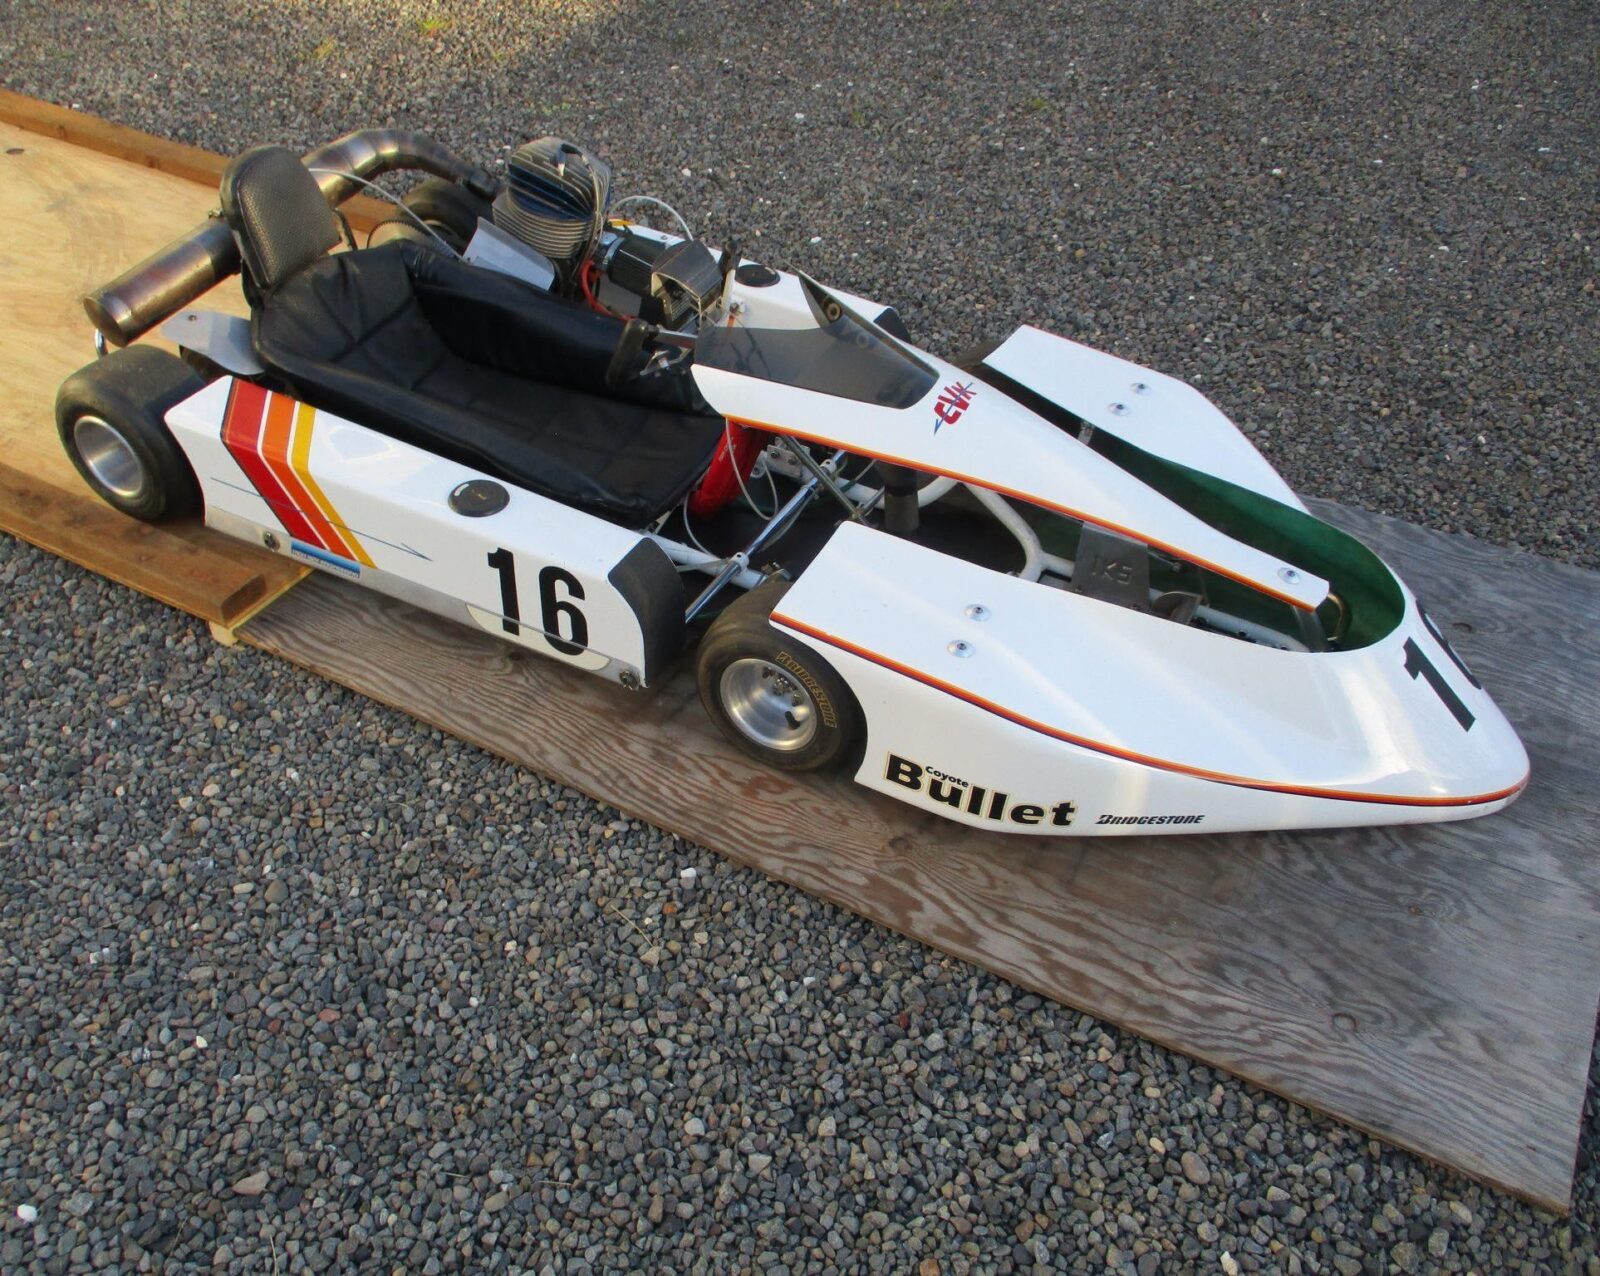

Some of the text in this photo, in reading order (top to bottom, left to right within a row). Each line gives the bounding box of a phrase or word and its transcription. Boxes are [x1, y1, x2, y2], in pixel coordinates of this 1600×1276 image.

[487, 547, 588, 656] 16
[884, 752, 1077, 827] Bullet
[925, 765, 969, 788] Coyote
[1094, 814, 1205, 825] BRIDGESTONE
